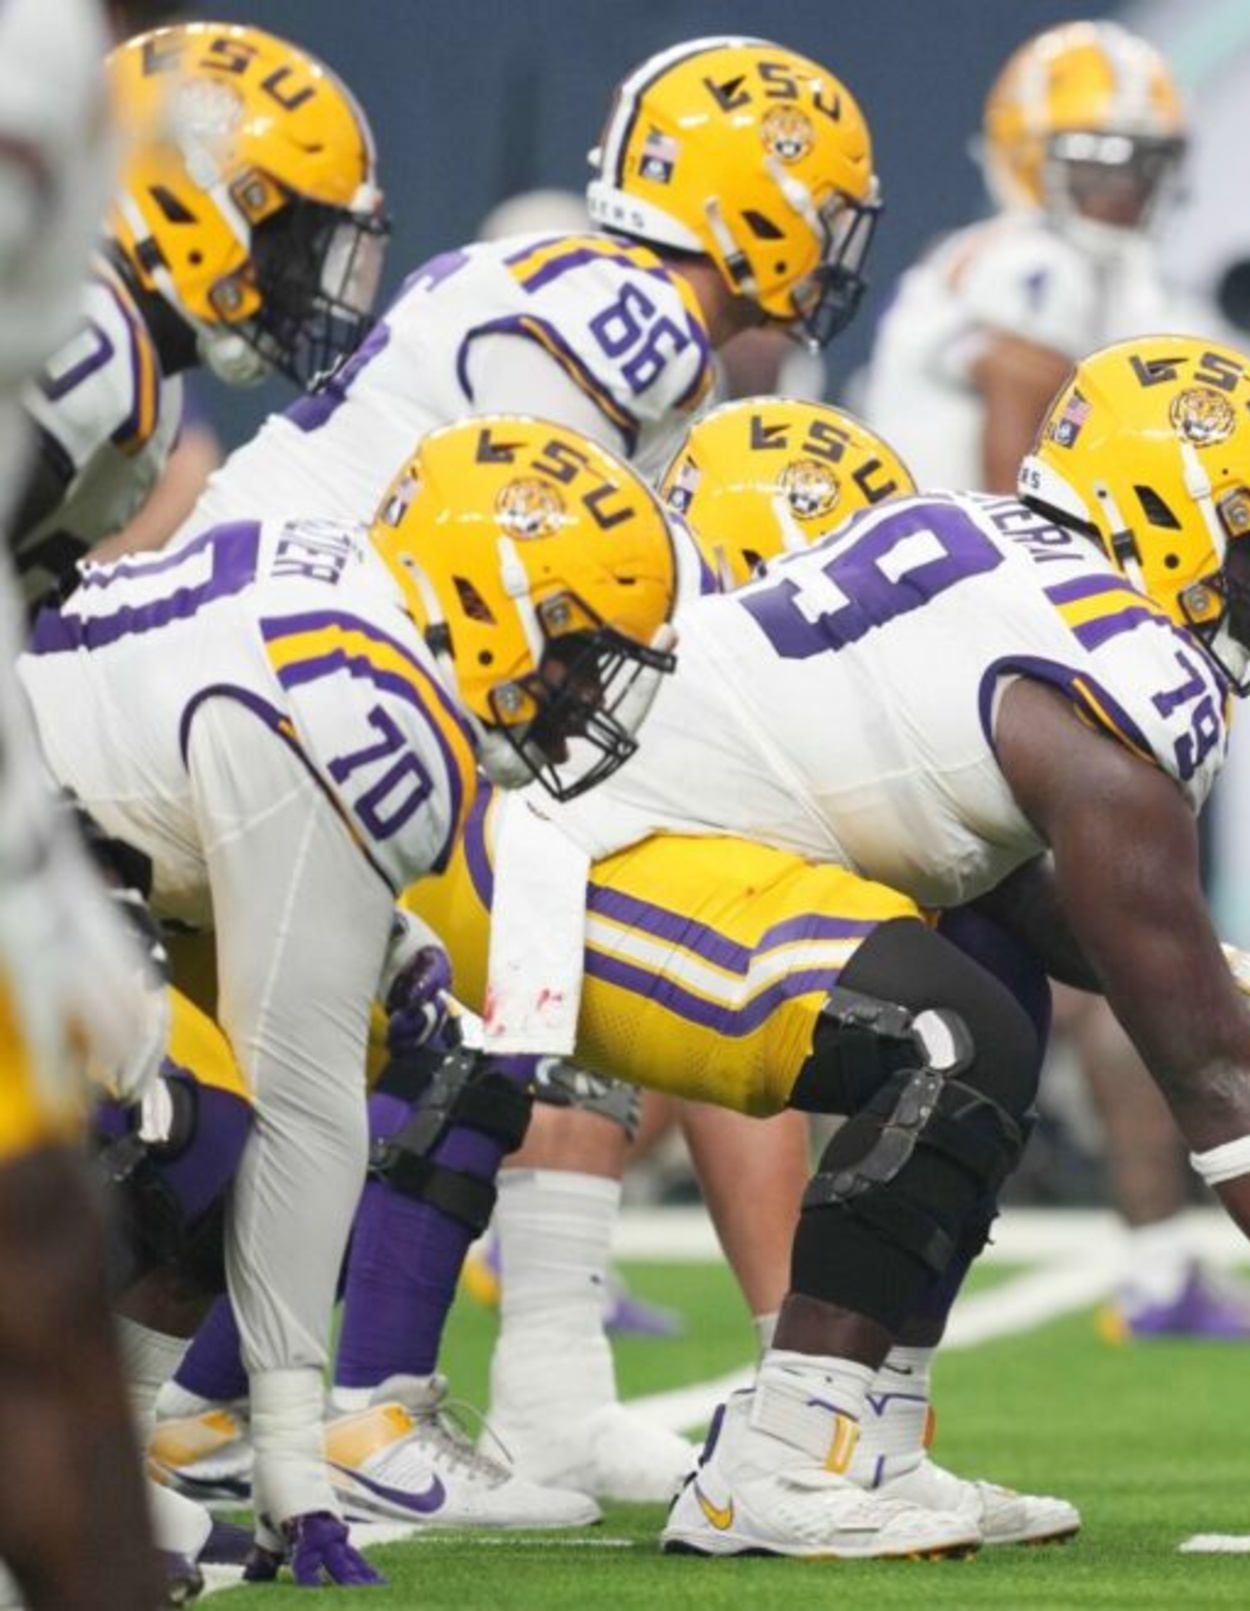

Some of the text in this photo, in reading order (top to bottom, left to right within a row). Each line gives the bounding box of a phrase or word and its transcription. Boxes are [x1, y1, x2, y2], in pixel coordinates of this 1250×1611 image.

[141, 37, 316, 112] LSU
[702, 61, 841, 123] LSU
[588, 281, 690, 395] 66
[475, 428, 636, 531] LSU
[750, 414, 898, 505] LSU
[738, 500, 1006, 660] 9
[1150, 650, 1220, 782] 79
[326, 703, 435, 842] 70
